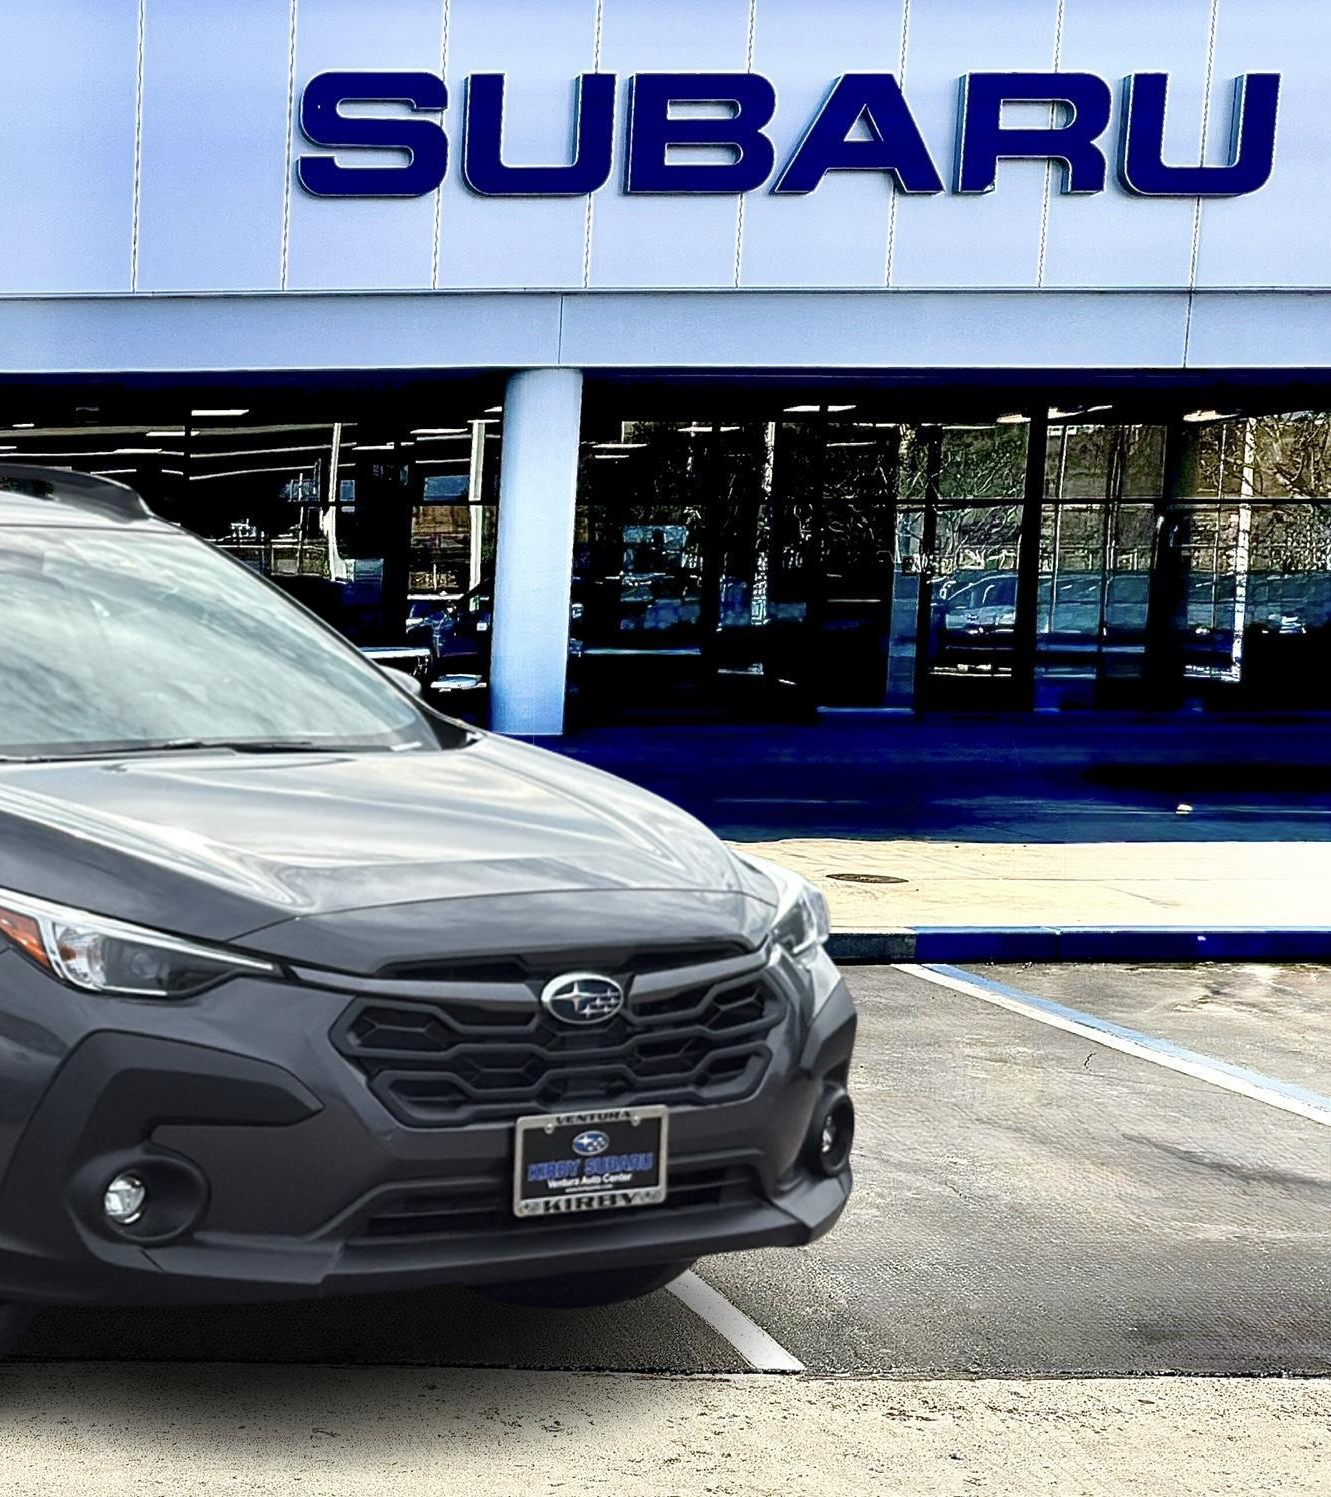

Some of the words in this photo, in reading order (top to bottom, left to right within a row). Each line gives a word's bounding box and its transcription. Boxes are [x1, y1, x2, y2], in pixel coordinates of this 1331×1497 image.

[296, 70, 1281, 198] SUBARU
[555, 1111, 632, 1125] VENTURA
[528, 1159, 580, 1181] KIRBY
[584, 1152, 654, 1174] SUBARU
[547, 1177, 580, 1189] Ventura
[581, 1175, 602, 1185] Auto
[602, 1172, 633, 1183] Center
[543, 1192, 638, 1212] KIRBY
